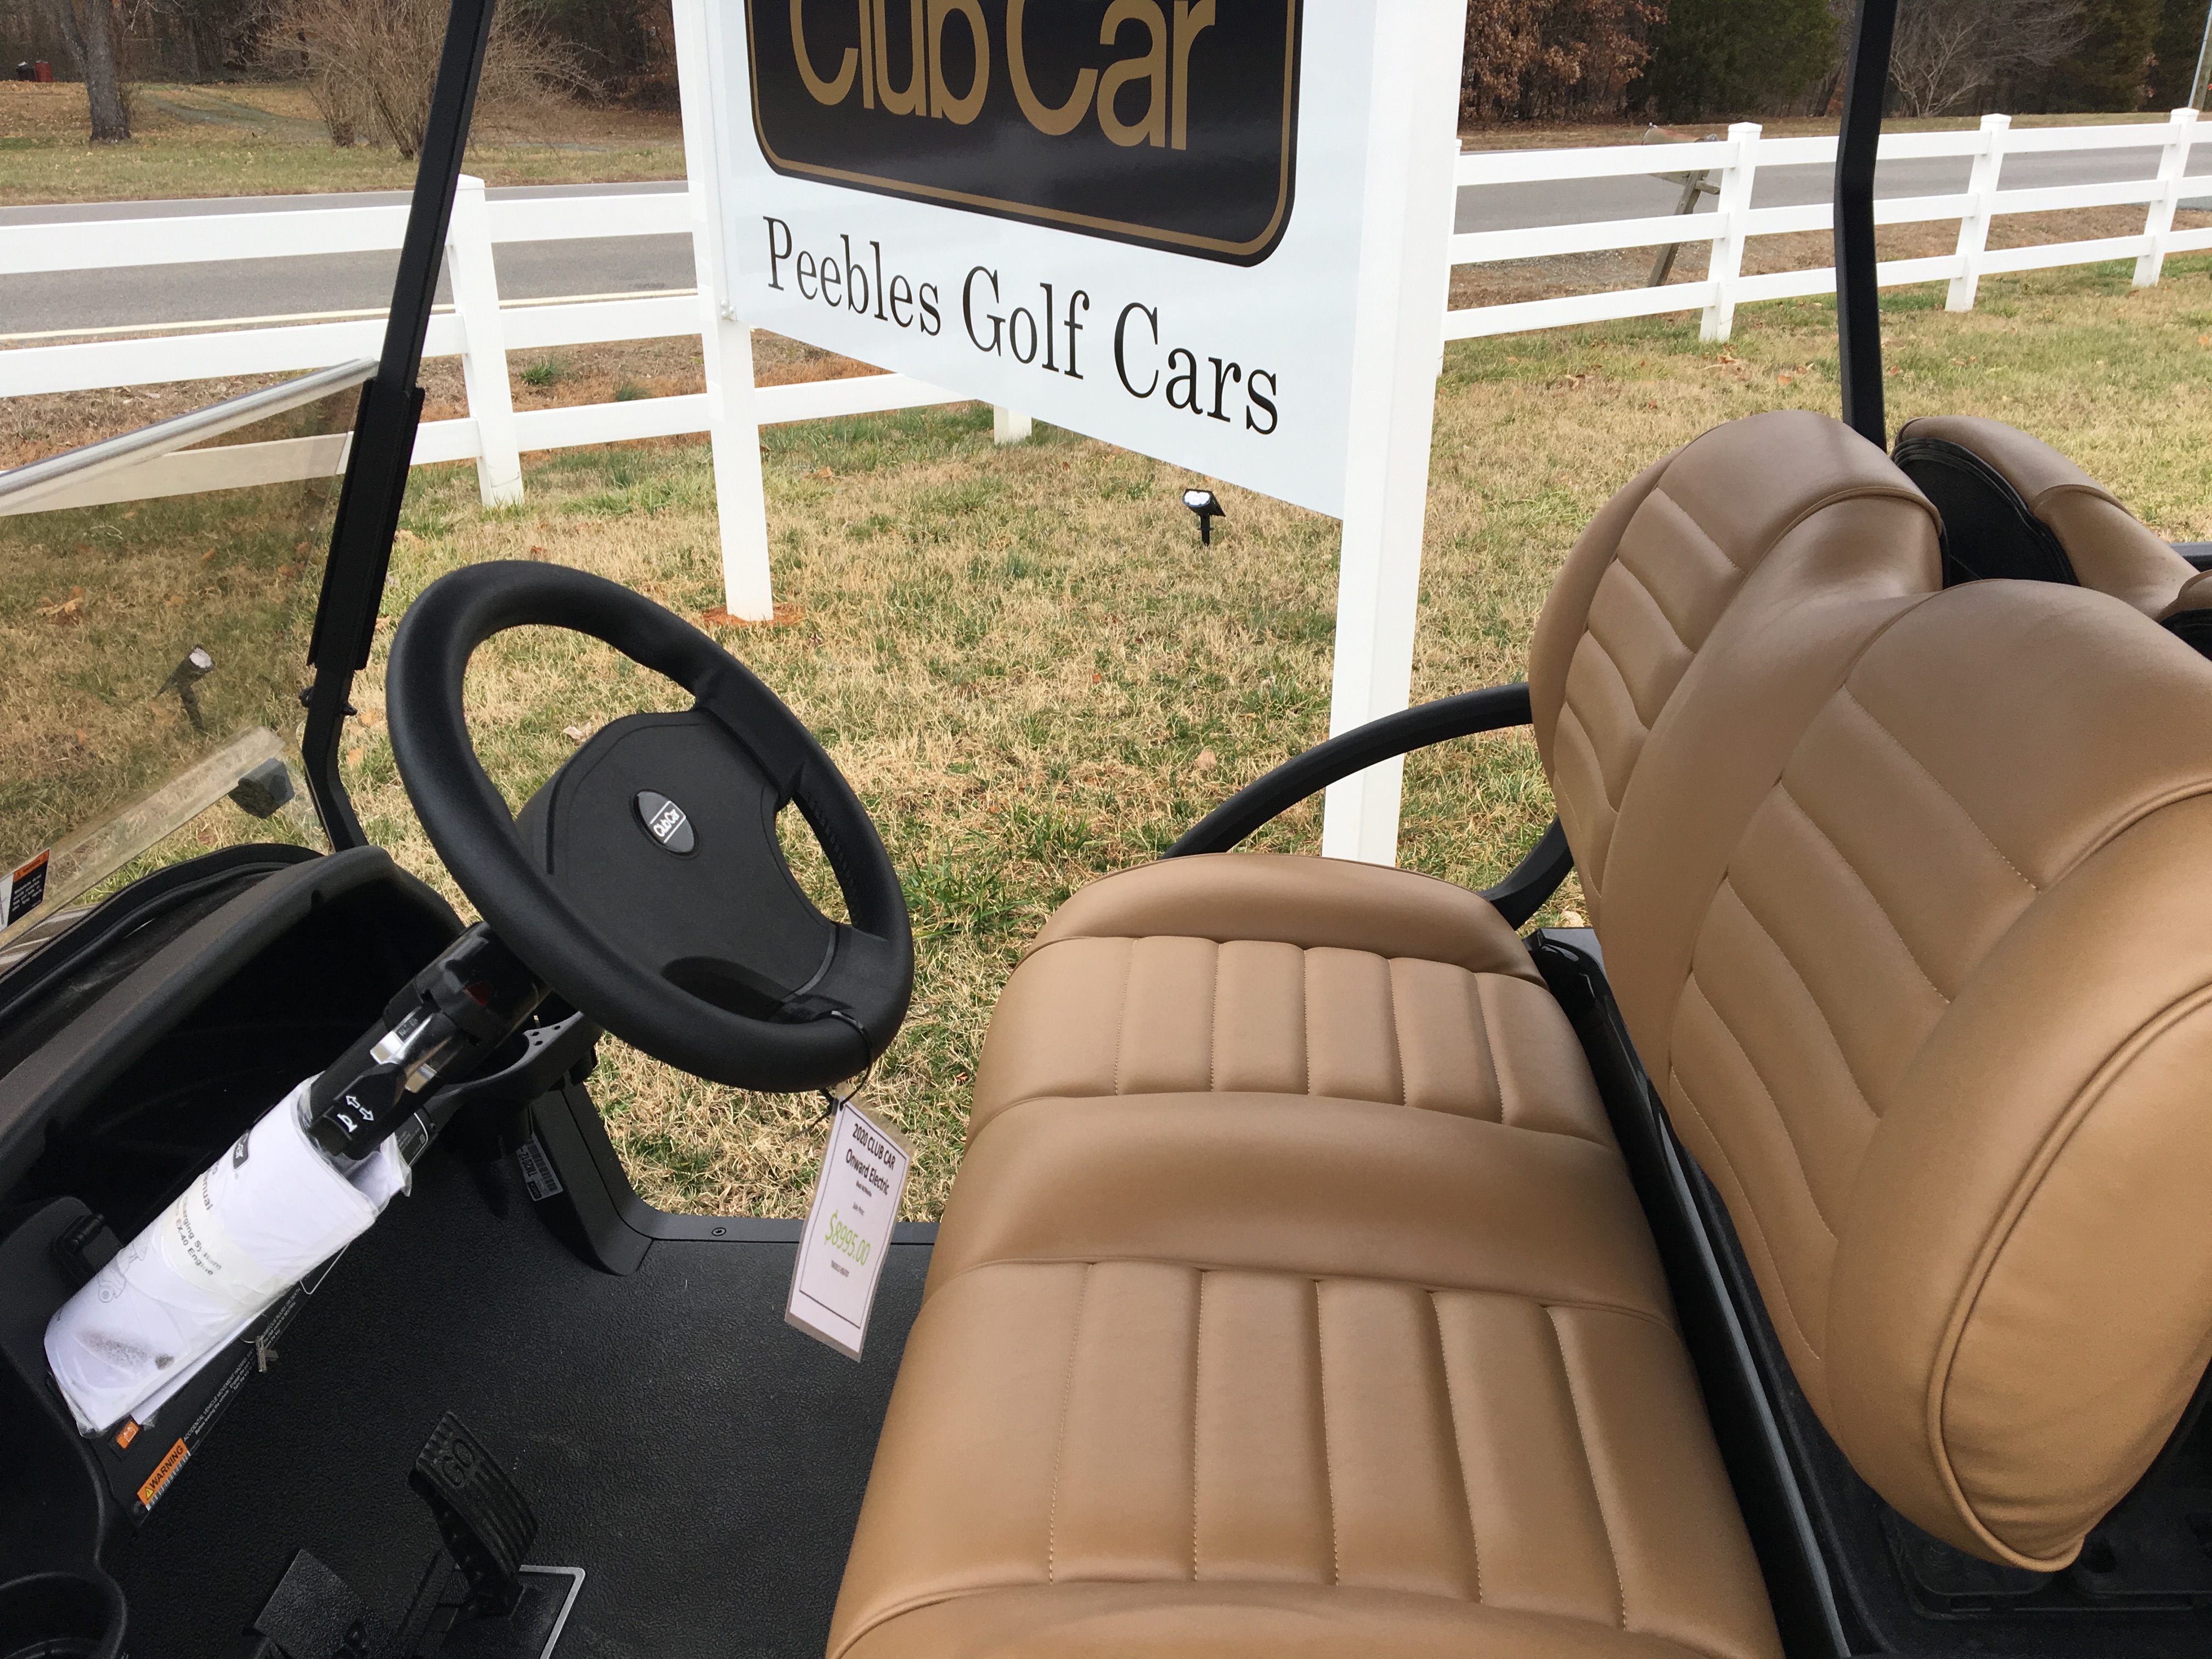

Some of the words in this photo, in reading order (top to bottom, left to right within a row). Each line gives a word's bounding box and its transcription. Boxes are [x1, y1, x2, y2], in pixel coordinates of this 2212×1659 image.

[789, 0, 991, 125] Club
[1006, 0, 1216, 151] Car
[763, 216, 941, 336] Peebles
[963, 266, 1090, 380] Golf
[1114, 302, 1278, 435] Cars
[852, 1123, 868, 1147] 2020
[867, 1137, 884, 1160] CLUB
[883, 1150, 895, 1170] CAR
[202, 1170, 214, 1211] anual
[846, 1148, 870, 1178] Onward
[868, 1167, 889, 1195] Electric
[176, 1219, 189, 1246] EX-40
[825, 1209, 871, 1266] $8995.00
[150, 1445, 184, 1488] WARNING
[442, 1437, 475, 1488] GO
